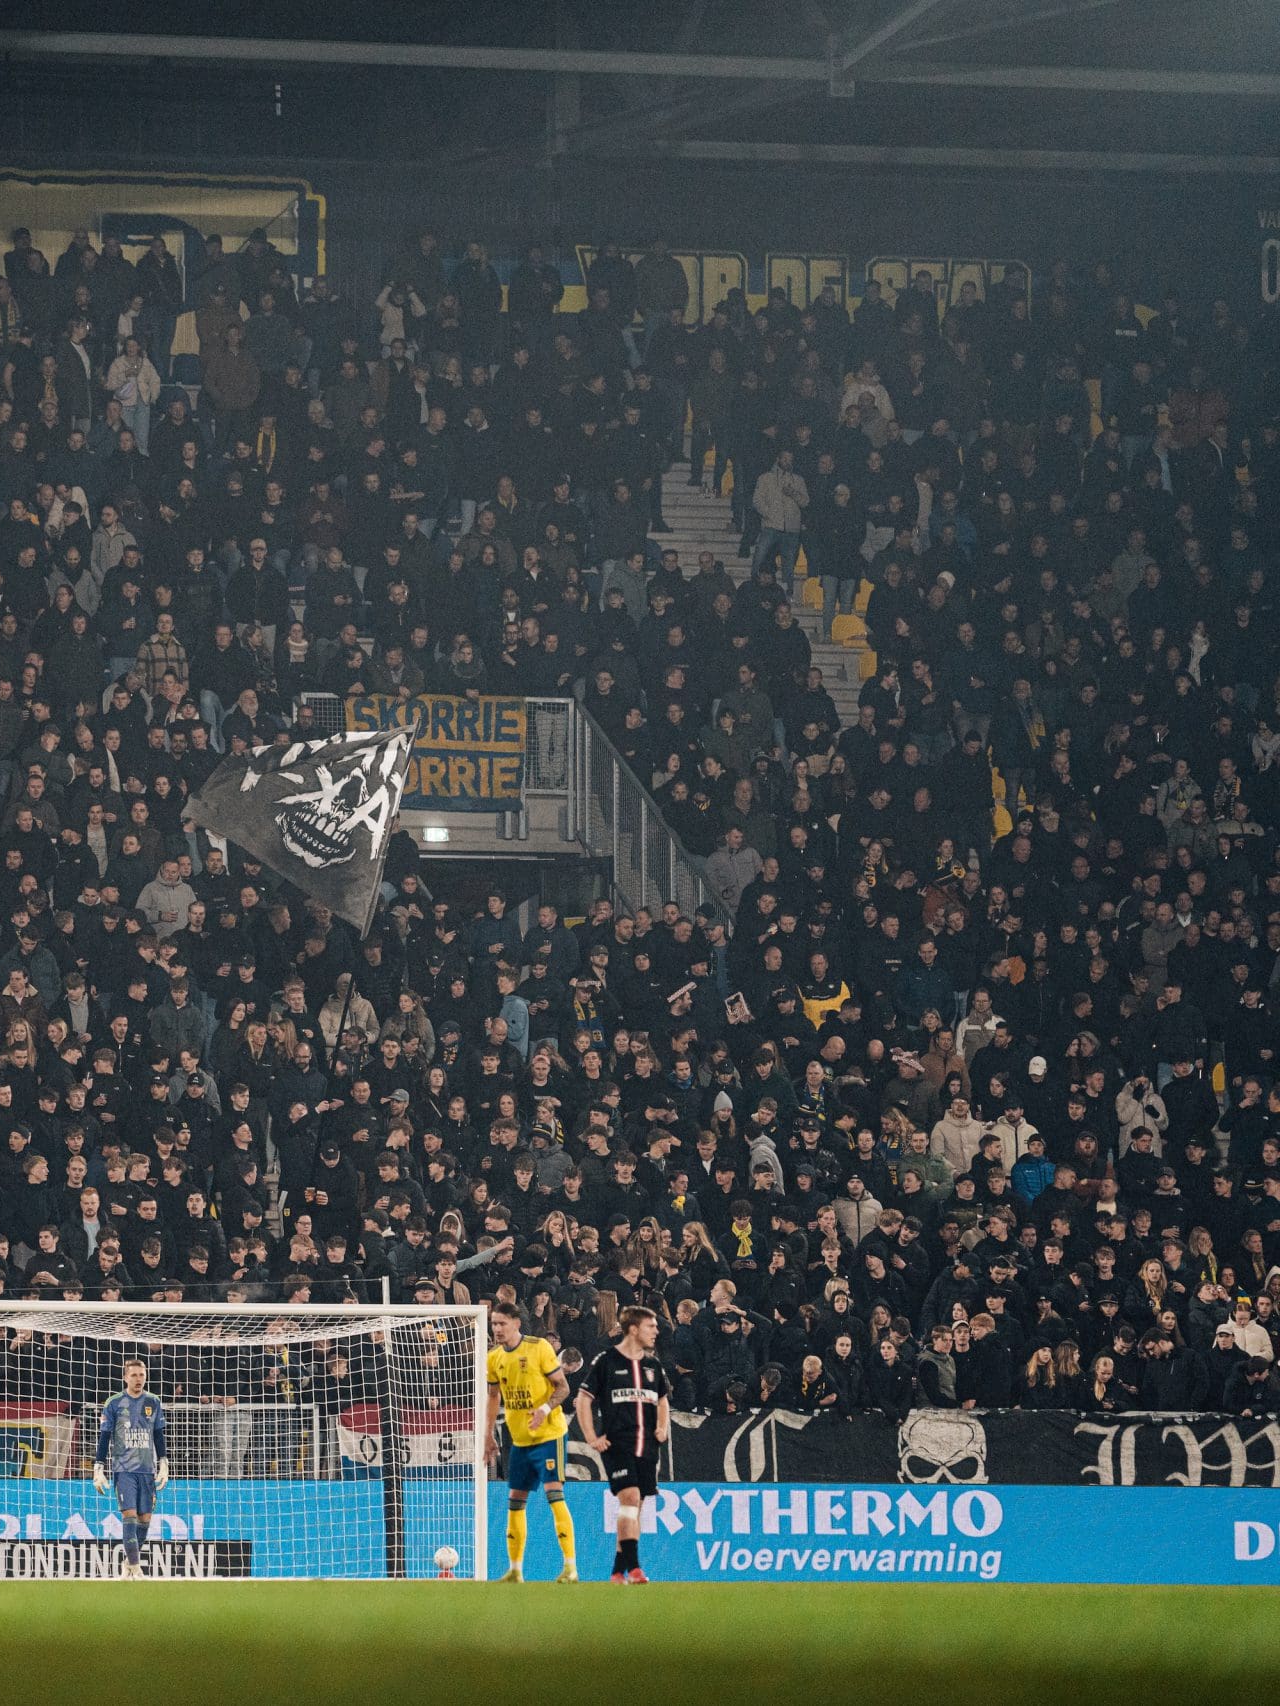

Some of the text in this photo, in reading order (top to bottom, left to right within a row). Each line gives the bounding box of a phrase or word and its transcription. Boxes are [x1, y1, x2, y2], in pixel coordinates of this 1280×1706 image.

[354, 700, 520, 743] SKORRIE
[403, 756, 520, 799] ORRIE
[696, 1541, 1001, 1580] Vloerverwarming
